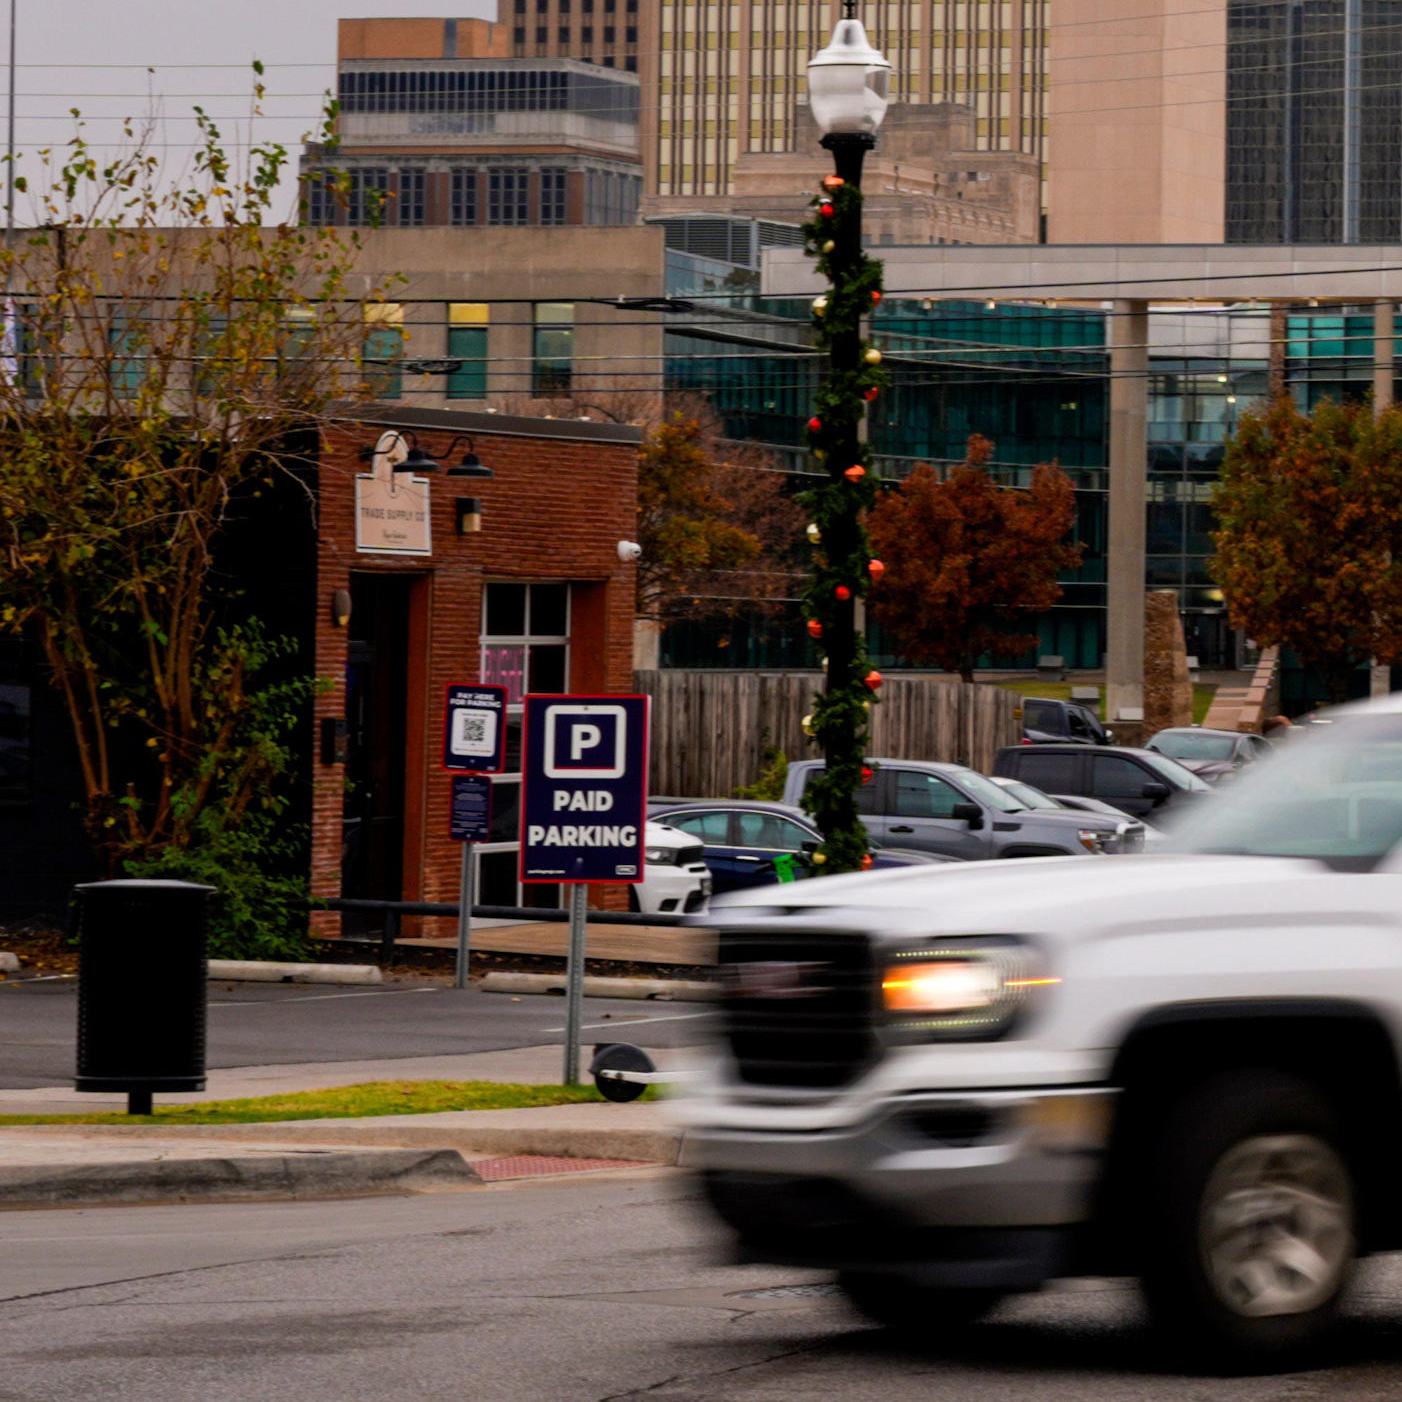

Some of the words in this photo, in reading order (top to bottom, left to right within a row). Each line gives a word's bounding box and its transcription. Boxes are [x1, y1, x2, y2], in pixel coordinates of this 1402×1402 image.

[360, 507, 385, 519] TRADE
[467, 700, 502, 708] PARKING
[570, 724, 602, 761] P
[553, 789, 614, 812] PAID
[527, 825, 637, 848] PARKING
